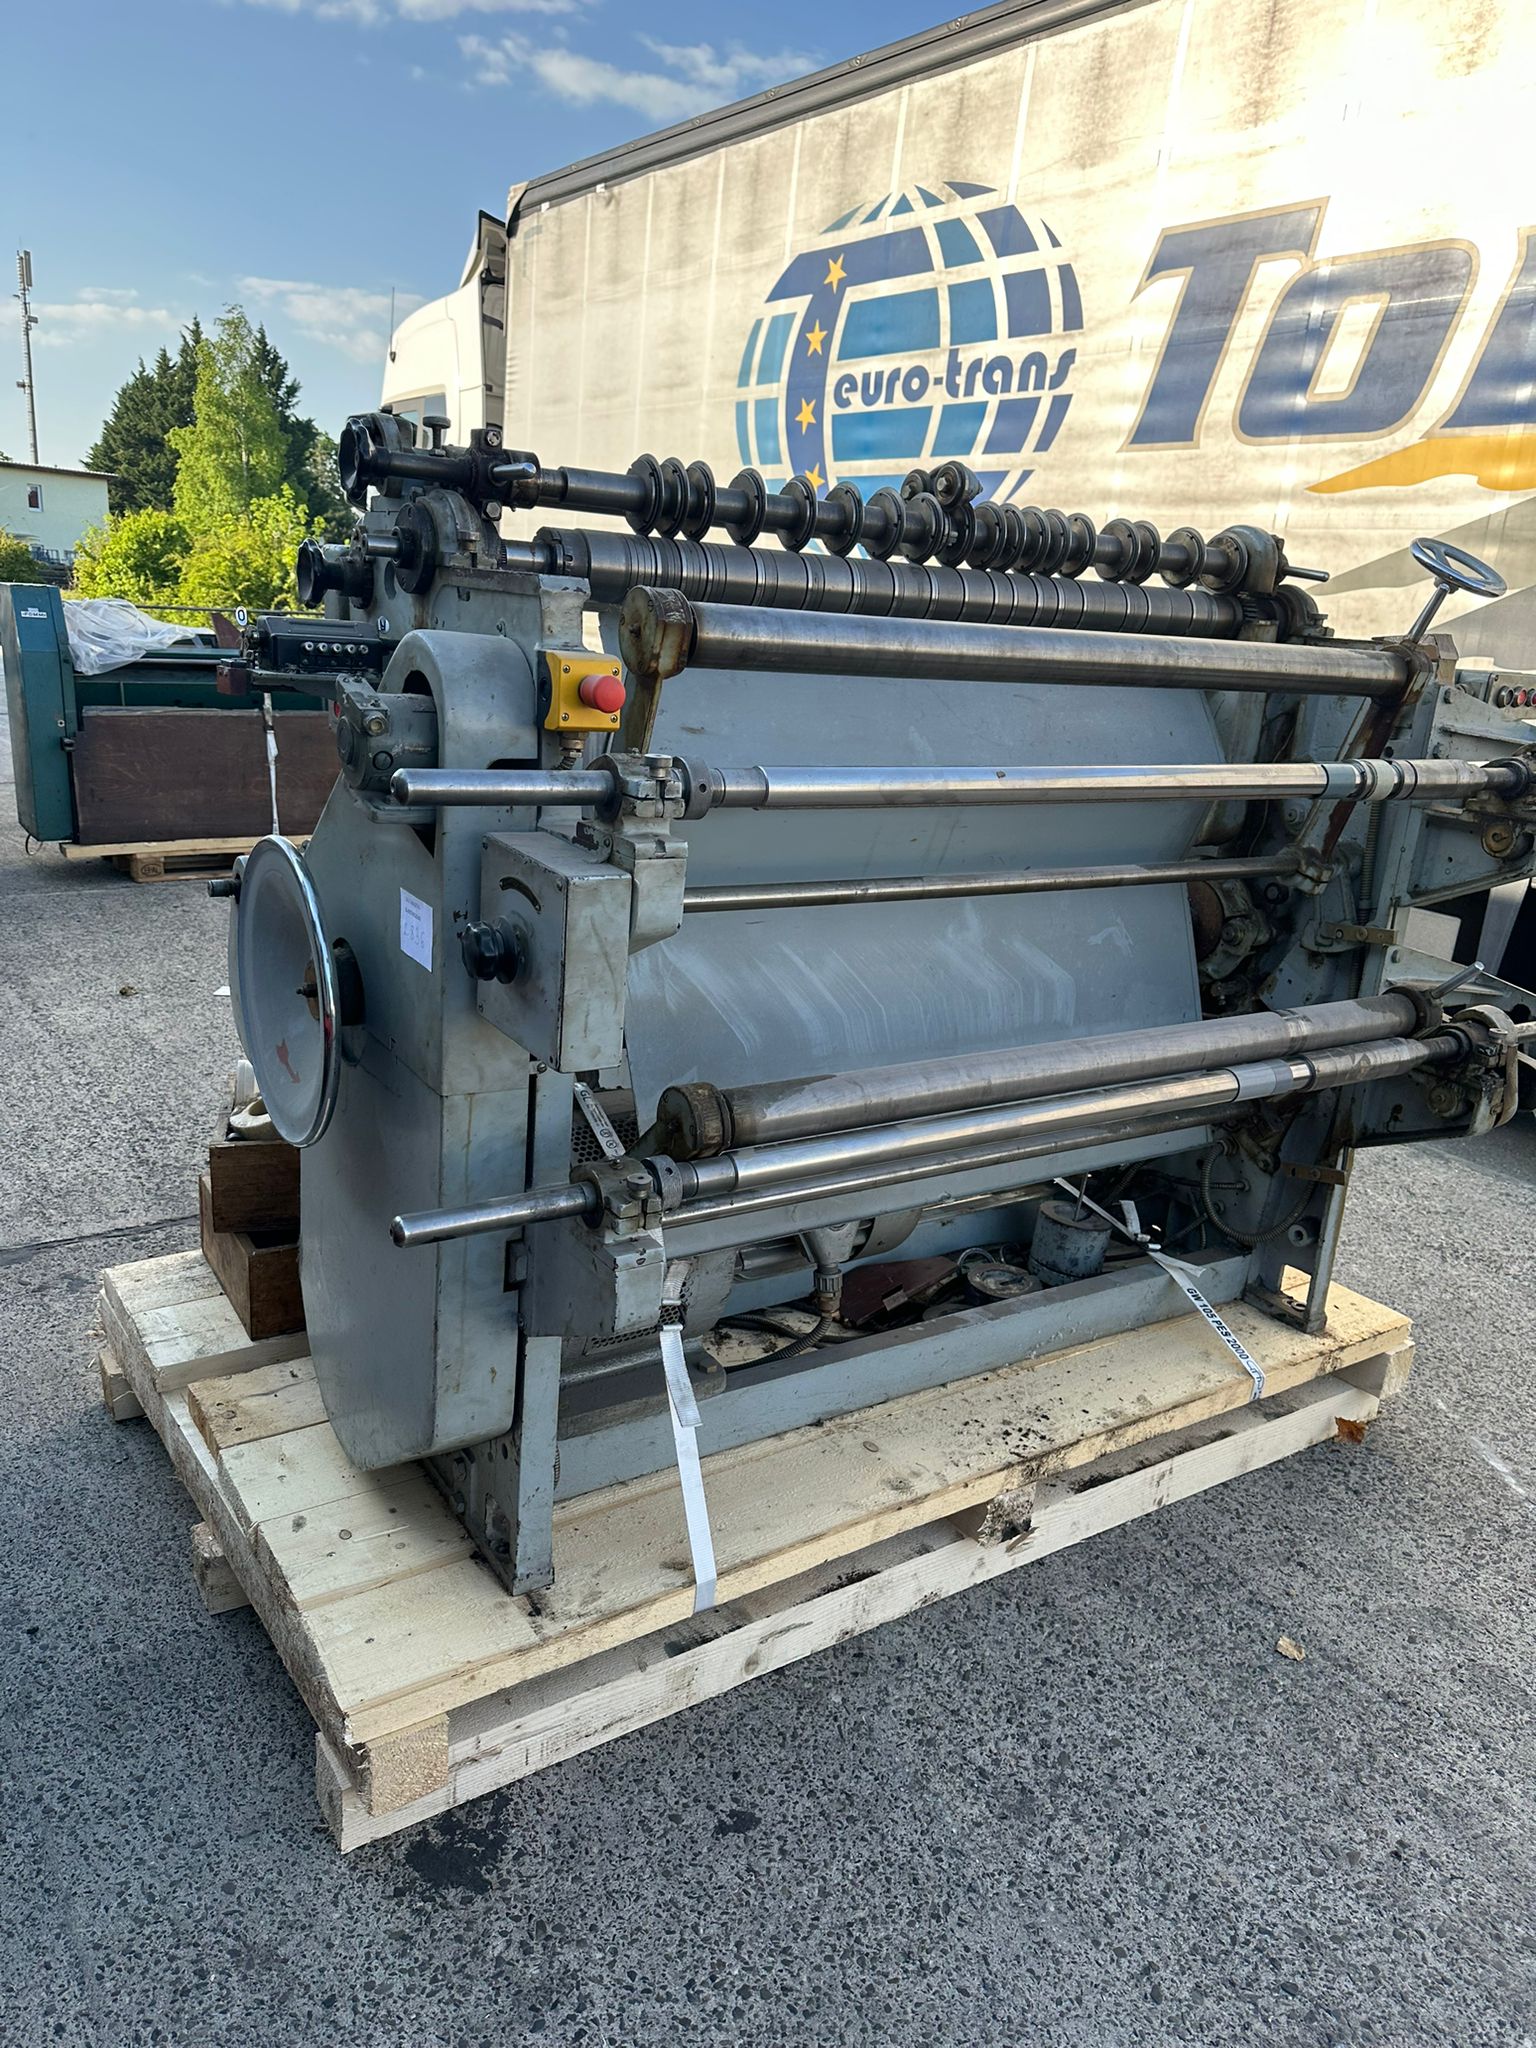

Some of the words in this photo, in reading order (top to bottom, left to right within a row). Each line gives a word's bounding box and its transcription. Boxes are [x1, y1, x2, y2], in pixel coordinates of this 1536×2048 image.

[833, 348, 1077, 409] euro-trans
[1186, 1287, 1204, 1302] GW
[1200, 1303, 1217, 1319] 105
[1212, 1320, 1231, 1337] PES
[1226, 1338, 1250, 1360] 2000
